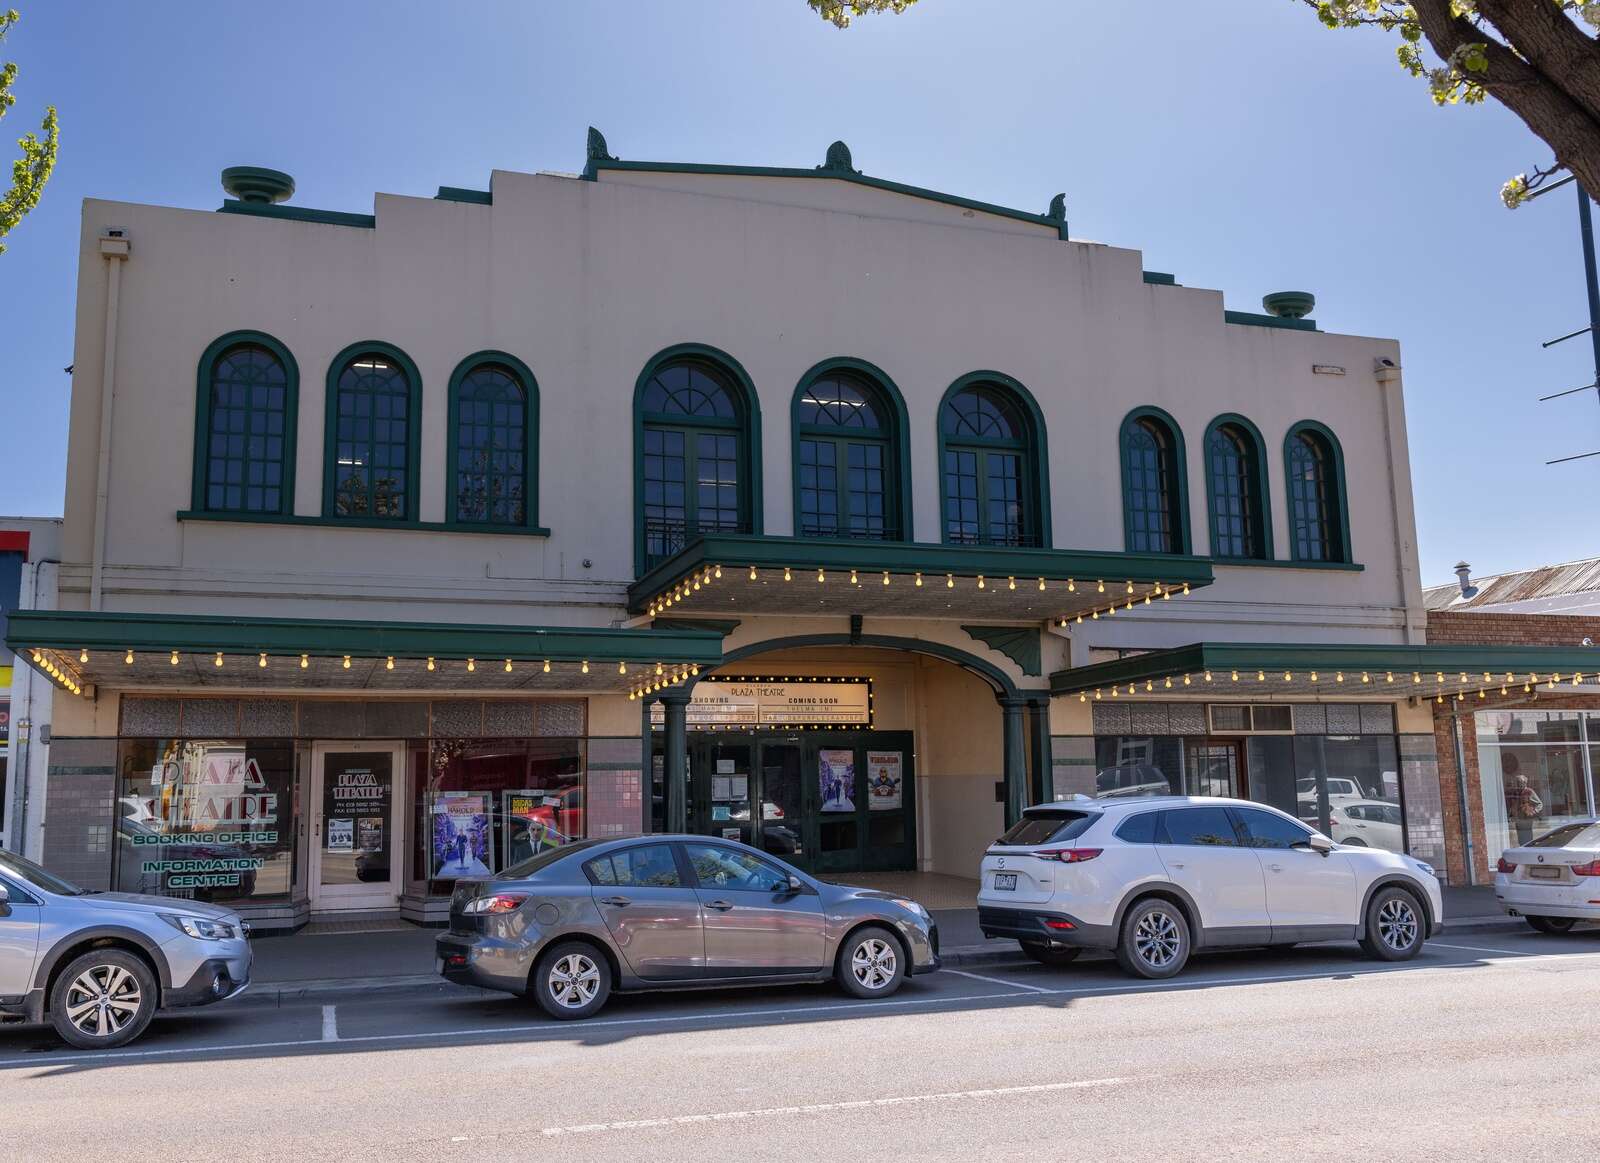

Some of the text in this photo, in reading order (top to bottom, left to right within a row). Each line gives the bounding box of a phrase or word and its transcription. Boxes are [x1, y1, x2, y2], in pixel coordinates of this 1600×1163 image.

[731, 687, 786, 697] PLAZA THEATRE
[162, 758, 266, 789] PLAZA
[338, 774, 378, 787] PLAZA
[132, 831, 278, 847] BOOKING OFFICE
[142, 858, 264, 873] INFORMATION
[168, 873, 240, 888] CENTRE
